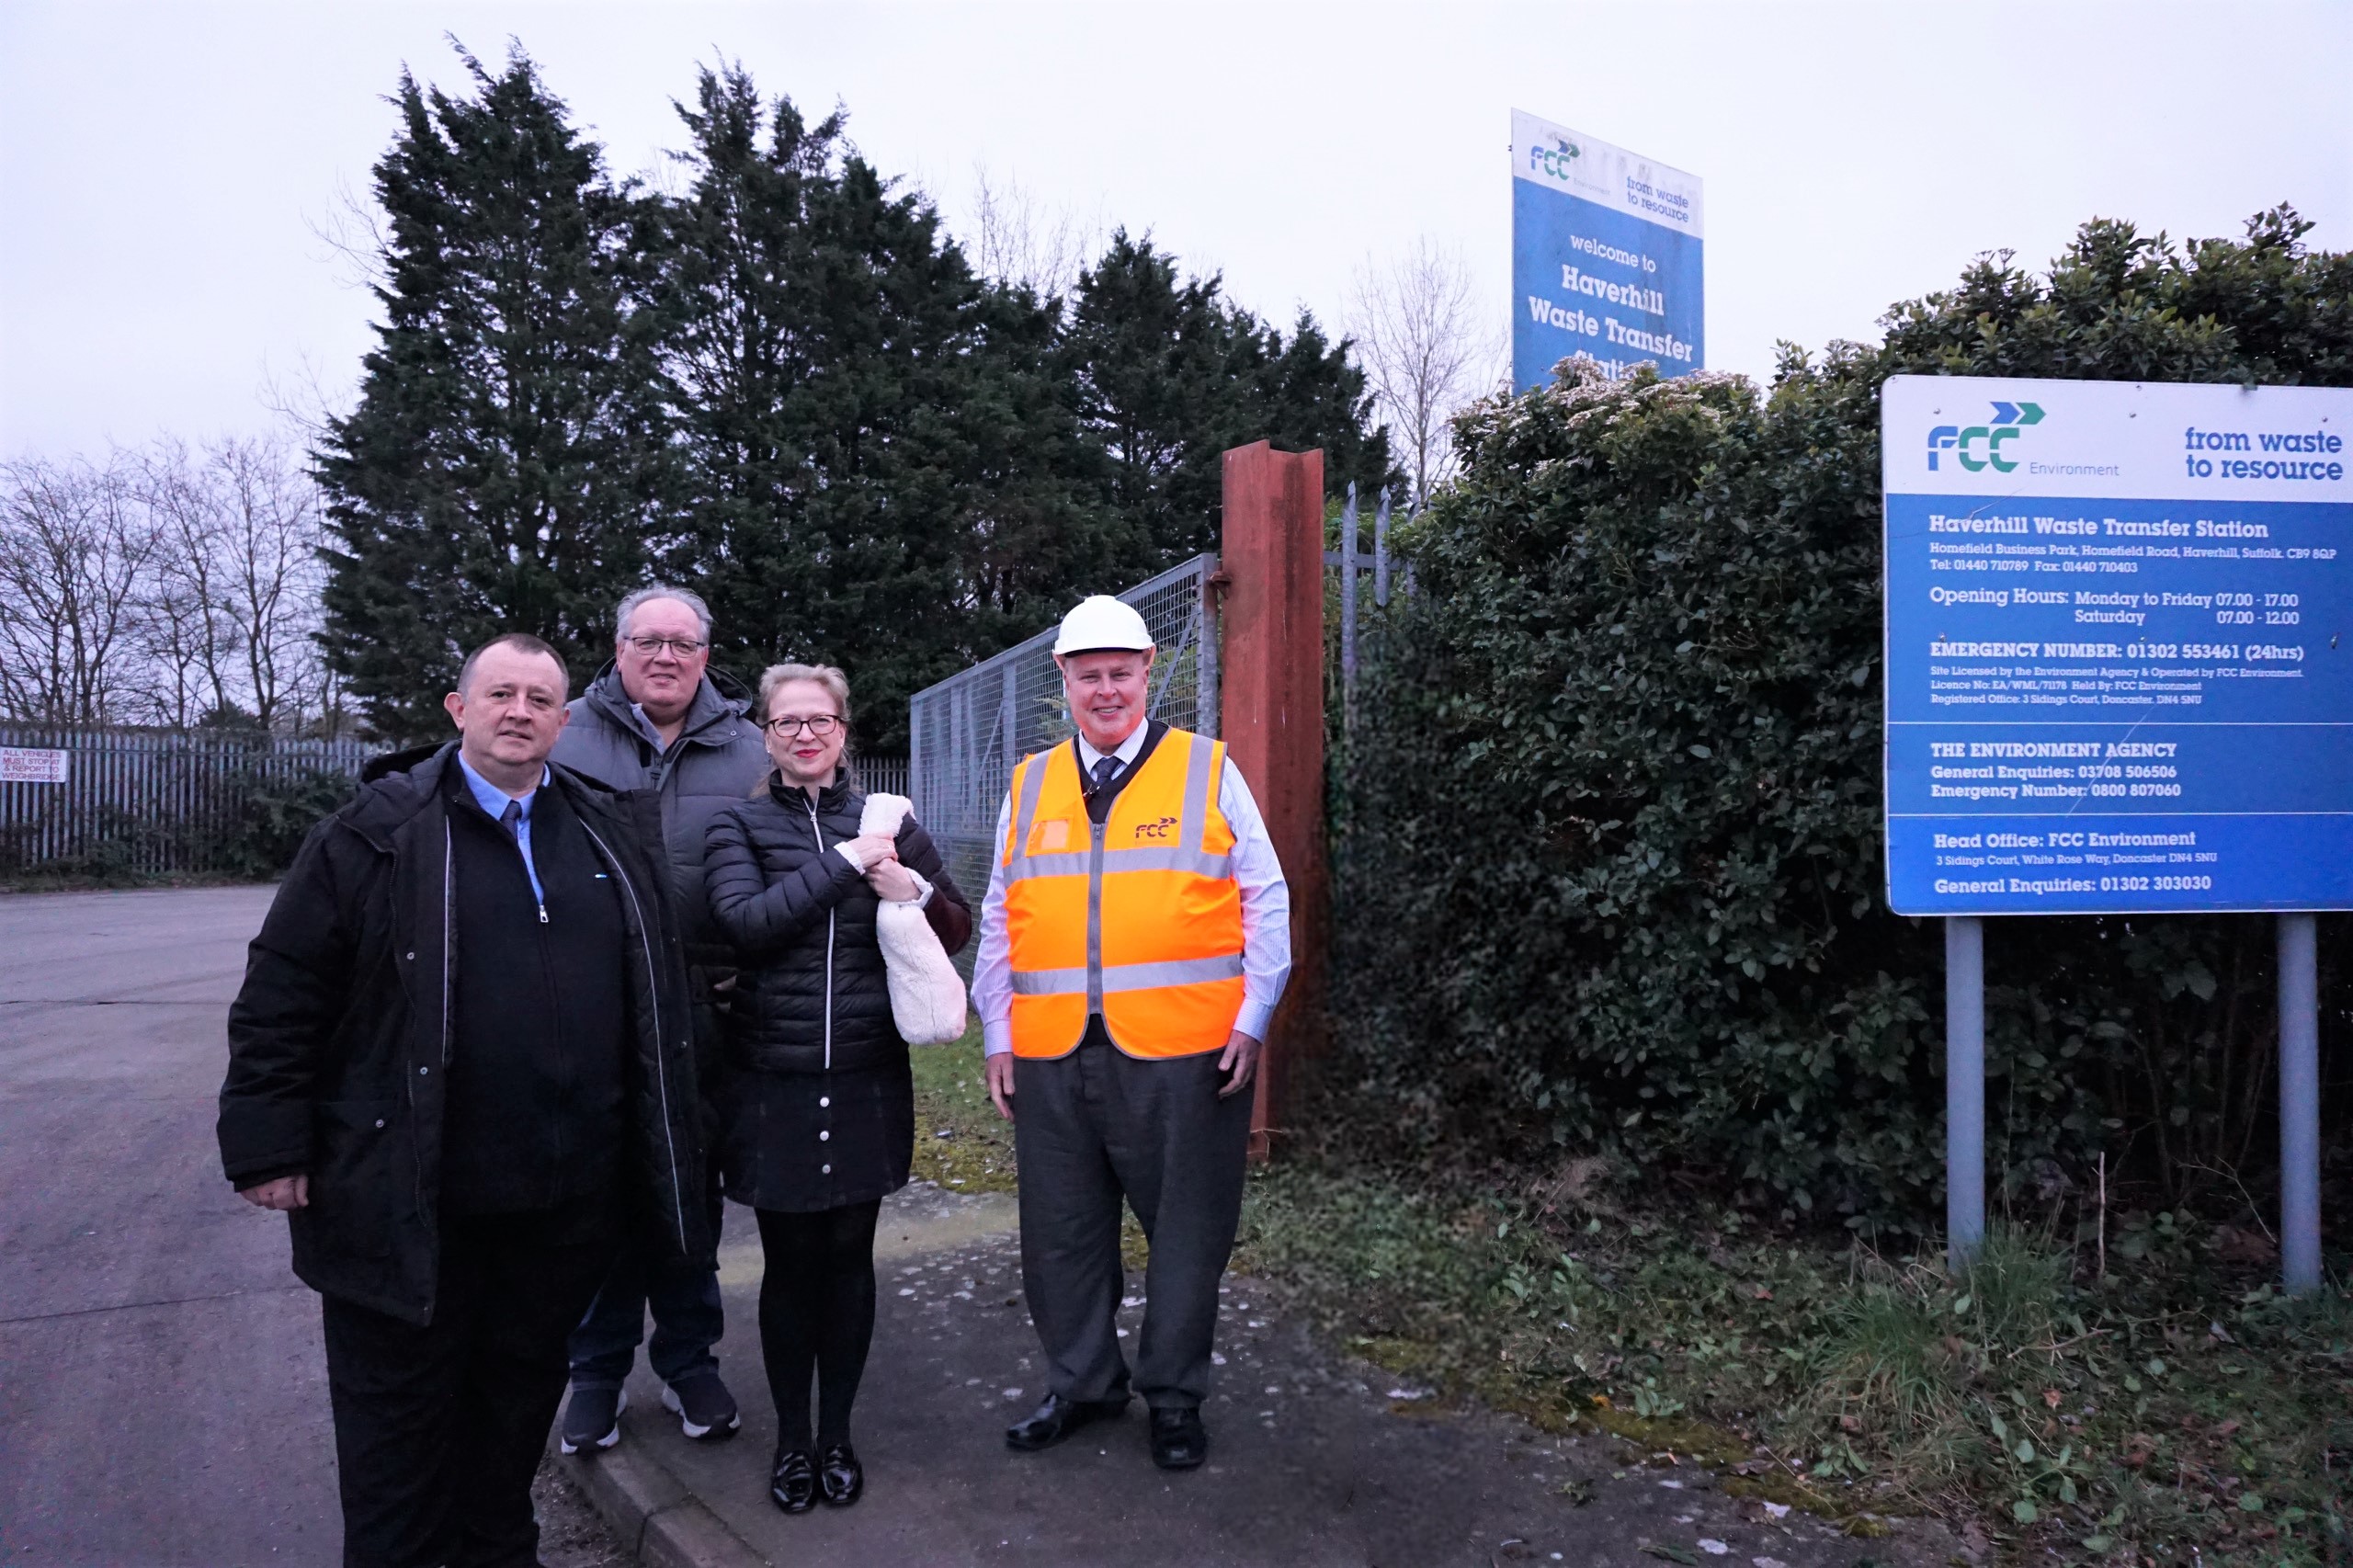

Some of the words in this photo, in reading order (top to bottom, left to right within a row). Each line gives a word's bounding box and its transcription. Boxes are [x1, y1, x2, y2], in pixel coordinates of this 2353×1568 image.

[1531, 145, 1571, 181] FCC
[1627, 176, 1653, 196] from
[1656, 188, 1689, 209] waste
[1628, 190, 1639, 205] to
[1642, 198, 1689, 222] resource
[1570, 235, 1639, 267] welcome
[1643, 255, 1656, 273] to
[1562, 264, 1665, 316] Haverhill
[1529, 296, 1599, 337] Waste
[1605, 317, 1693, 362] Transfer
[2185, 426, 2252, 452] from
[2258, 430, 2343, 454] waste
[1927, 426, 2020, 472] FCC
[2029, 461, 2120, 476] Environment
[2186, 454, 2213, 478] to
[2221, 460, 2344, 481] resource
[1929, 515, 2029, 534] Haverhill
[2033, 517, 2098, 535] Waste
[2103, 518, 2191, 537] Transfer
[2195, 520, 2269, 538] Station
[1930, 542, 1993, 554] Homefield
[1995, 543, 2047, 555] Business
[2049, 544, 2079, 557] Park,
[2082, 545, 2143, 557] Homefield
[2146, 546, 2181, 559] Road,
[2183, 547, 2241, 560] Haverhill,
[2287, 549, 2311, 559] CB9
[2313, 549, 2337, 560] 8QP
[1930, 559, 1951, 571] Tel:
[1954, 560, 1988, 571] 01440
[1991, 561, 2029, 572] 710789
[2063, 562, 2097, 573] 01440
[2098, 562, 2138, 573] 710403
[1930, 586, 2008, 608] Opening
[2013, 588, 2069, 604] Hours:
[2075, 591, 2140, 608] Monday
[2143, 593, 2159, 606] to
[2162, 593, 2213, 608] Friday
[2216, 593, 2254, 607] 07.00
[2264, 594, 2299, 607] 17.00
[2075, 609, 2145, 626] Saturday
[2217, 611, 2254, 624] 07.00
[2266, 612, 2299, 625] 12.00
[1930, 642, 2040, 657] EMERGENCY
[2044, 643, 2122, 658] NUMBER:
[2127, 644, 2178, 659] 01302
[2182, 644, 2240, 659] 553461
[2245, 644, 2304, 663] (24hrs)
[1931, 666, 1949, 676] Site
[1951, 666, 1996, 676] Licensed
[1999, 666, 2013, 677] by
[2015, 667, 2032, 676] the
[2034, 667, 2097, 676] Environment
[2099, 667, 2140, 679] Agency
[2141, 668, 2149, 676] &
[2151, 667, 2200, 678] Operated
[2201, 668, 2214, 679] by
[2216, 668, 2238, 677] FCC
[1931, 681, 1971, 690] Licence
[2072, 681, 2096, 690] Held
[2115, 681, 2137, 690] FCC
[2138, 682, 2202, 690] Environment
[1931, 695, 1985, 705] Registered
[1988, 695, 2021, 704] Office:
[2023, 695, 2029, 704] 3
[2030, 695, 2067, 705] Sidings
[2156, 696, 2178, 705] DN4
[2180, 696, 2202, 705] 5NU
[22, 750, 62, 758] VEHICLES
[1930, 743, 1966, 757] THE
[1970, 743, 2102, 757] ENVIRONMENT
[2105, 743, 2177, 757] AGENCY
[2, 772, 61, 781] WEIGHBRIDGE
[1931, 766, 1994, 778] General
[1997, 766, 2075, 780] Enquiries:
[2078, 766, 2121, 778] 03708
[2125, 766, 2177, 778] 506506
[1931, 784, 2018, 800] Emergency
[2022, 784, 2087, 797] Number:
[2091, 784, 2126, 797] 0800
[2130, 784, 2182, 797] 807060
[1135, 824, 1169, 838] FCC
[1934, 834, 1983, 848] Head
[1986, 833, 2044, 847] Office:
[2048, 833, 2085, 846] FCC
[2088, 831, 2196, 846] Environment
[1936, 856, 1943, 866] 3
[1945, 856, 1984, 868] Sidings
[1987, 855, 2020, 866] Court,
[2022, 855, 2054, 865] White
[2057, 854, 2083, 864] Rose
[2113, 853, 2166, 864] Doncaster
[2168, 853, 2193, 863] DN4
[2195, 852, 2218, 862] 5NU
[1935, 879, 2006, 893] General
[2010, 878, 2097, 895] Enquiries:
[2100, 876, 2149, 892] 01302
[2153, 875, 2211, 891] 303030
